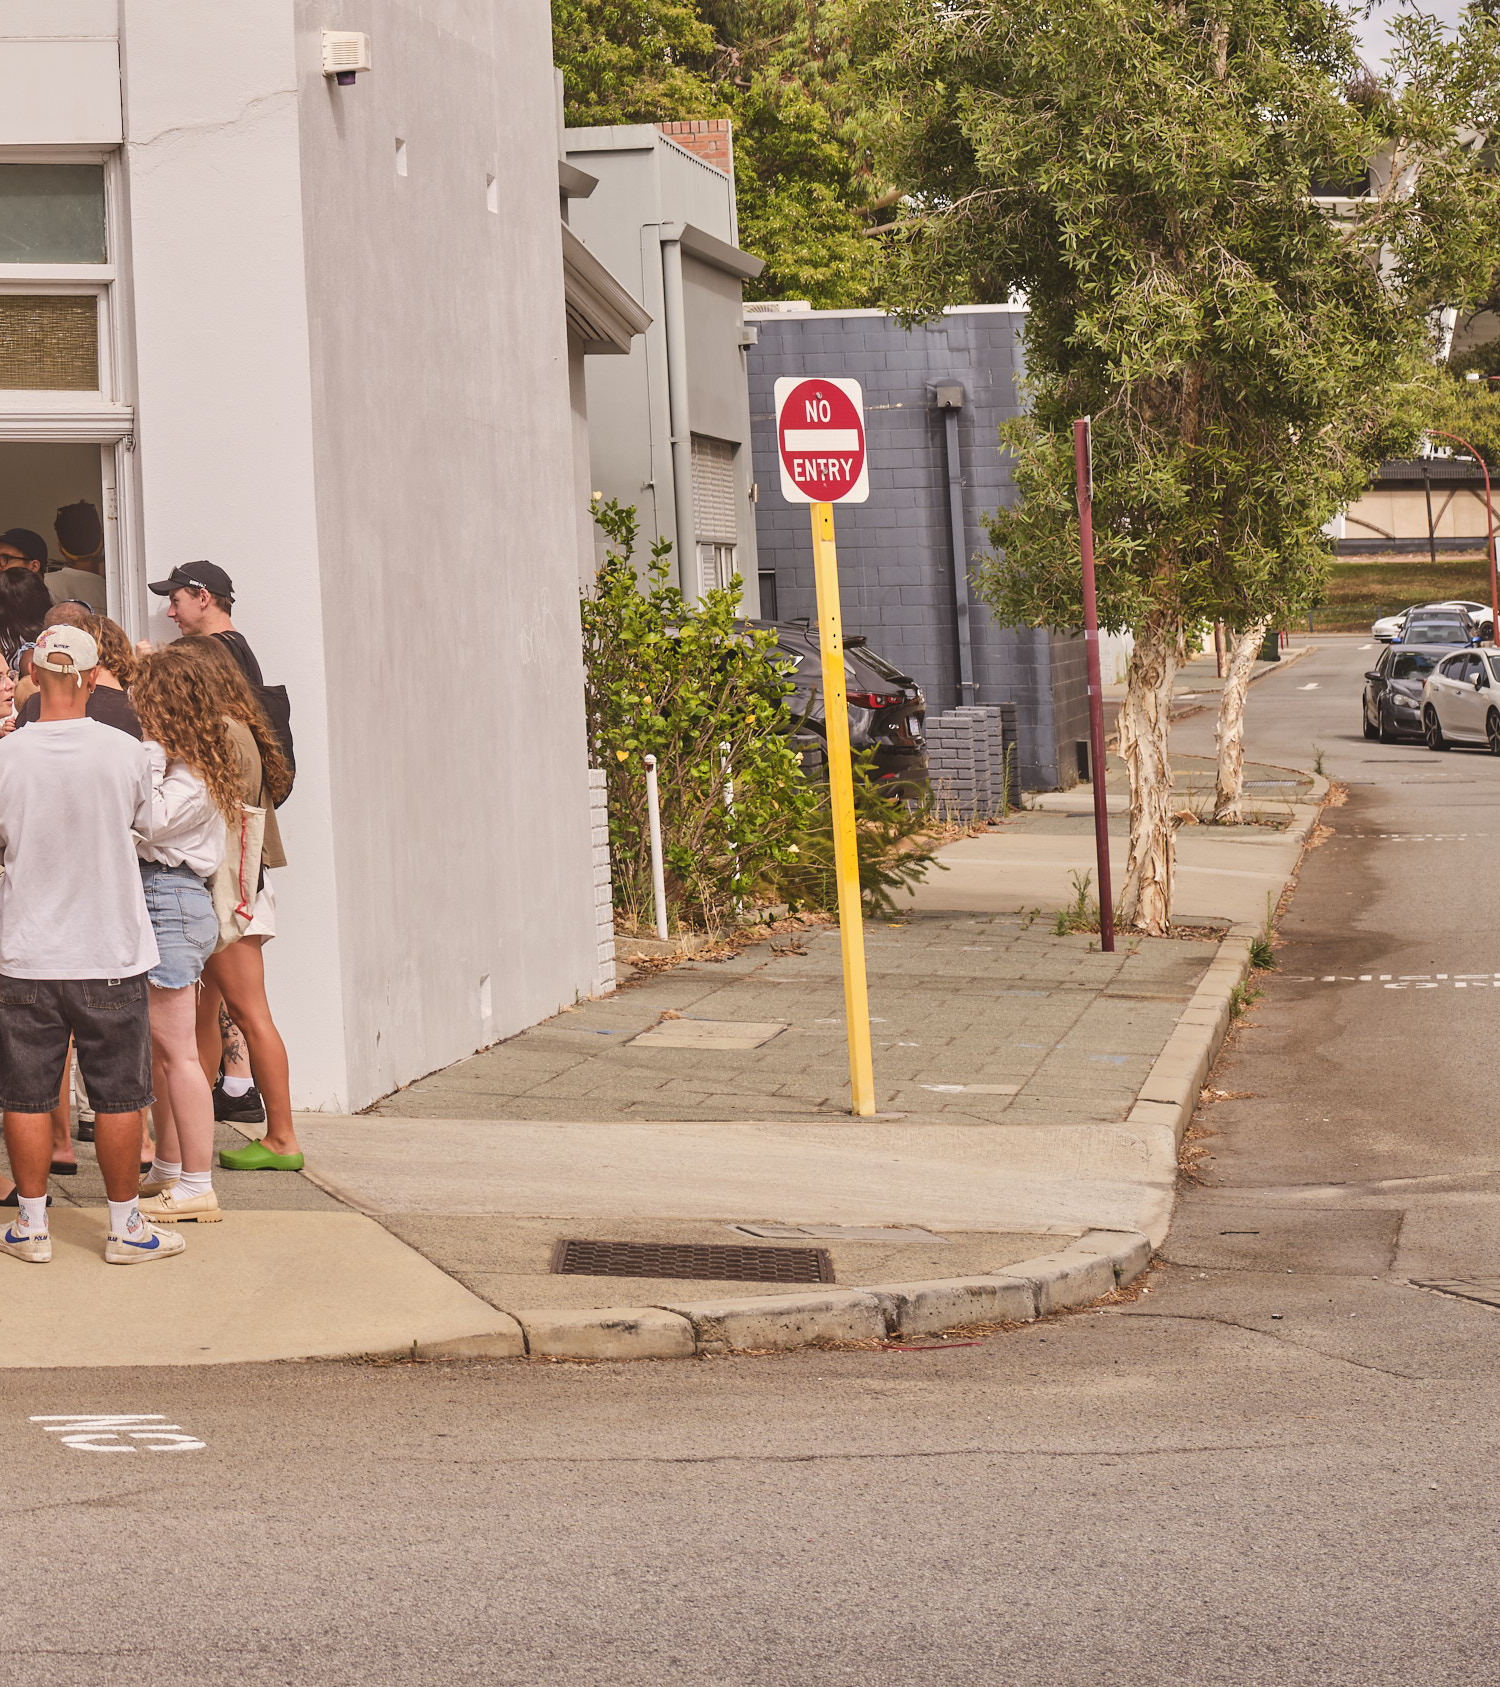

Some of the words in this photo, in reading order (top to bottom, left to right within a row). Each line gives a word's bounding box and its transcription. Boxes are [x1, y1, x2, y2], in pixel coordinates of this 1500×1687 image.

[805, 399, 831, 423] NO
[793, 458, 853, 482] ENTRY
[28, 1414, 208, 1452] NO
